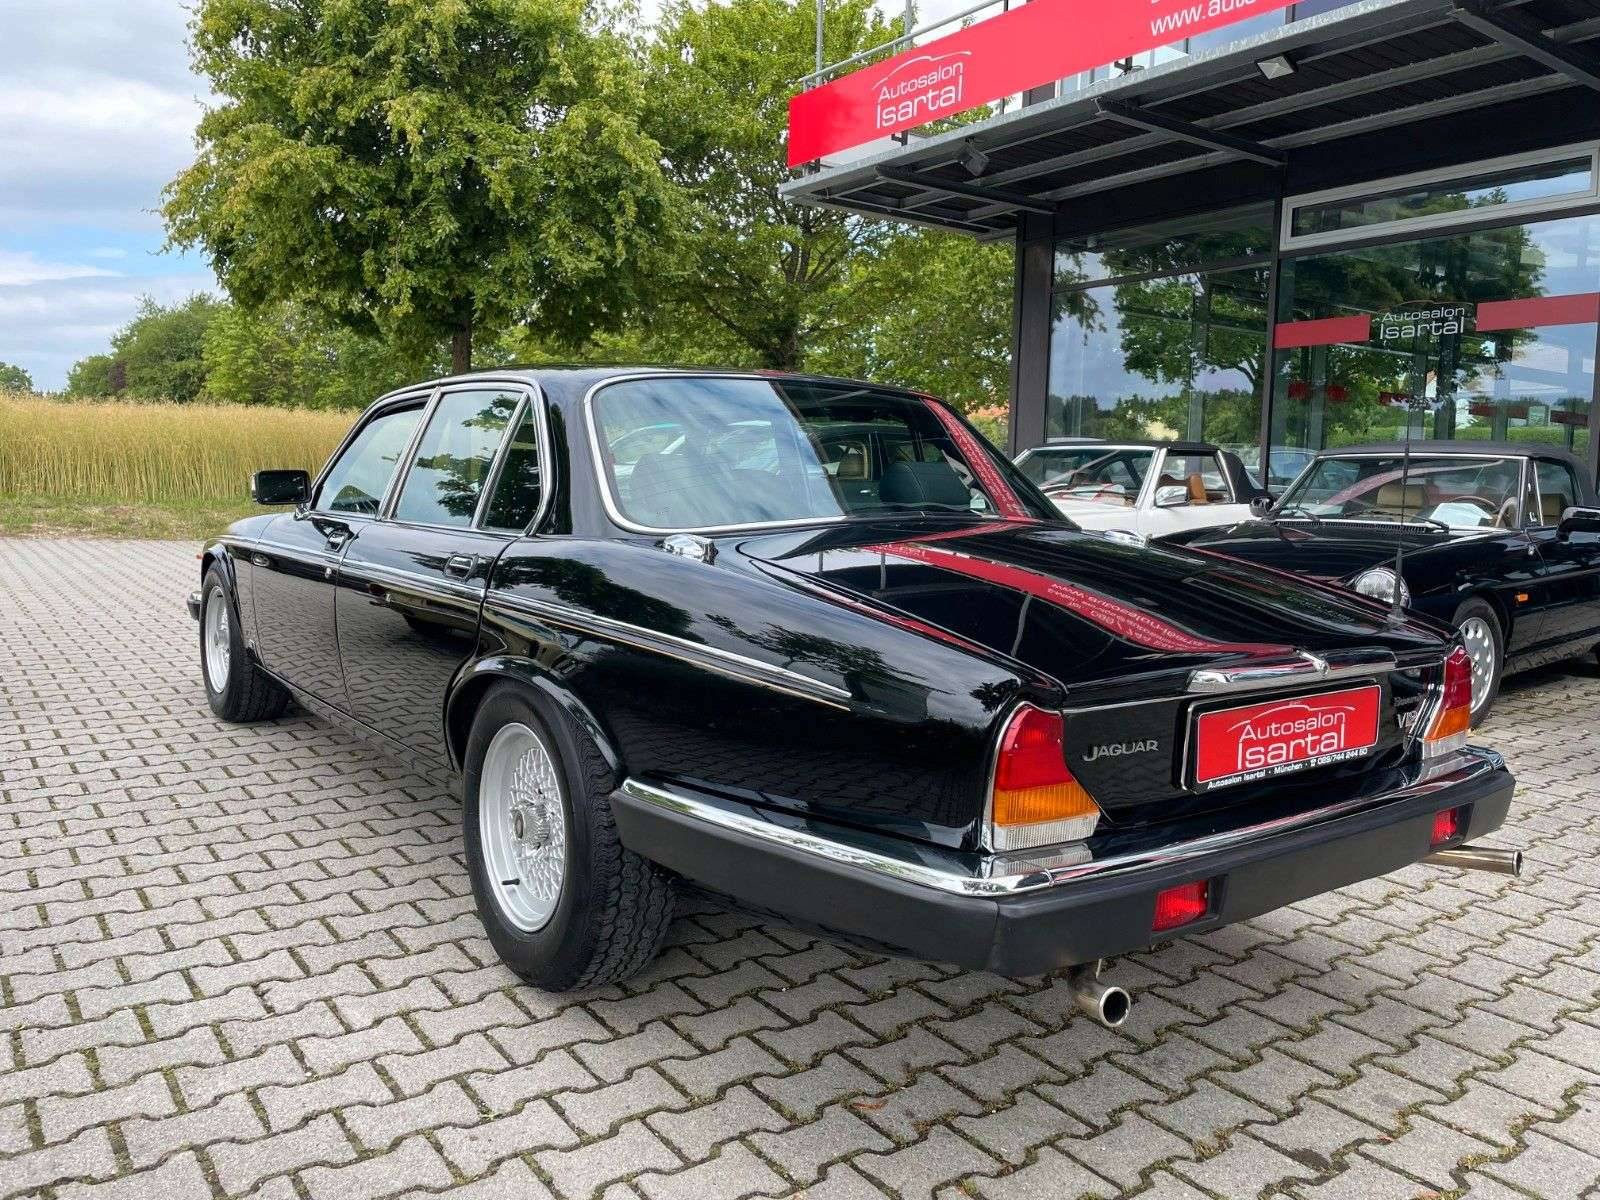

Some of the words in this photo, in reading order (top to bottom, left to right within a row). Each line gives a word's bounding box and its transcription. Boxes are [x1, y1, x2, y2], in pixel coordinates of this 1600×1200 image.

[1151, 0, 1256, 36] www.au
[877, 61, 964, 103] Autosalon
[876, 77, 963, 129] Isartal
[1379, 316, 1465, 340] Isartal
[1381, 307, 1464, 322] Autosalon
[1240, 710, 1346, 743] Autosalon
[1082, 739, 1160, 763] JAGUAR
[1237, 723, 1345, 770] Isartal
[1207, 776, 1242, 790] Autosalon
[1273, 763, 1302, 774] München
